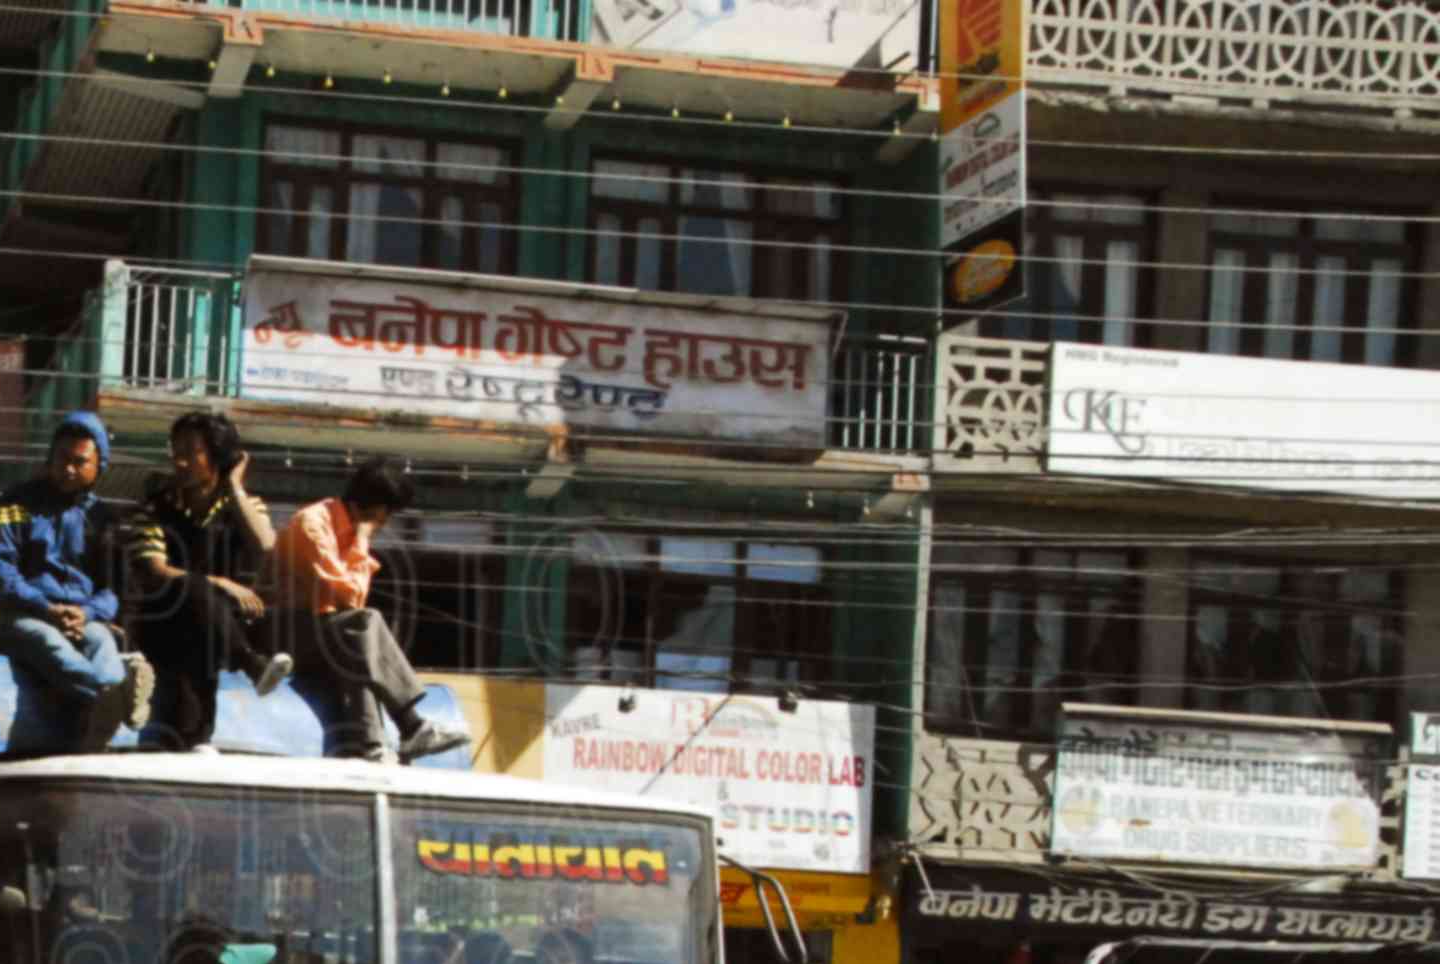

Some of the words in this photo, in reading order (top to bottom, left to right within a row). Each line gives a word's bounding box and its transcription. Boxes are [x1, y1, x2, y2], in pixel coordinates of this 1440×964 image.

[328, 295, 486, 363] बनेपा
[641, 326, 815, 390] हाउस
[573, 736, 667, 775] RAINBOW
[672, 743, 750, 780] DIGITAL
[755, 751, 823, 785] COLOR
[826, 755, 866, 788] LAB
[720, 803, 854, 836] STUDIO
[919, 884, 1020, 920] बनेपा
